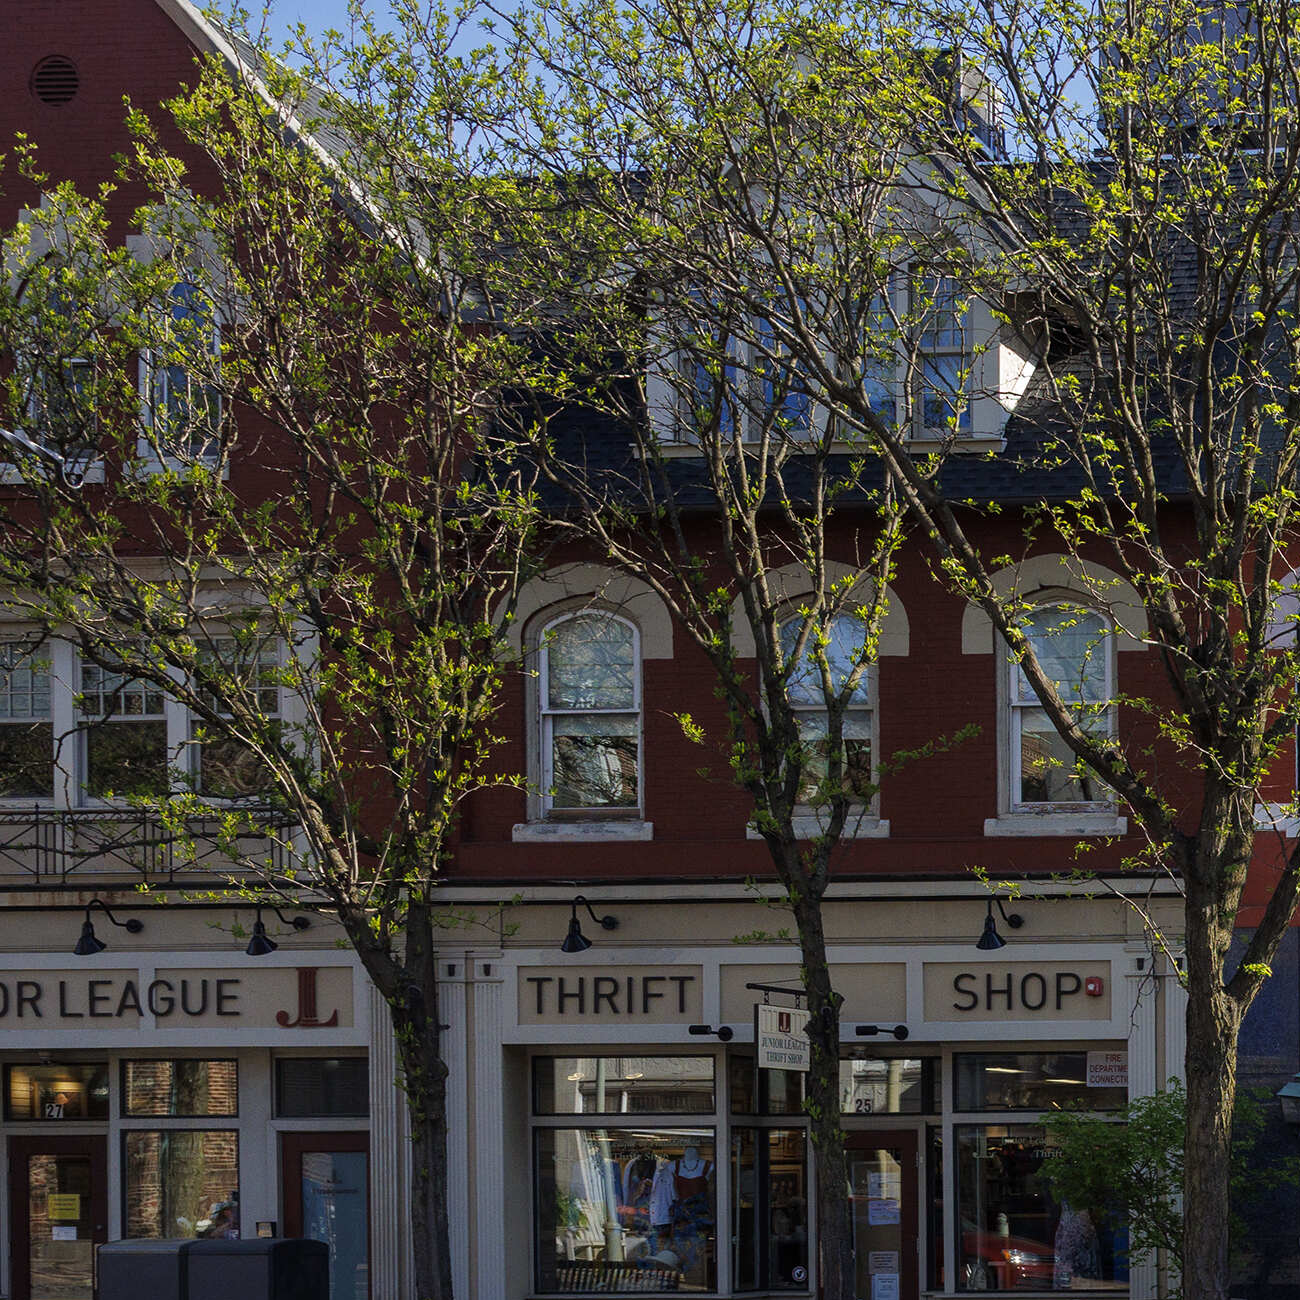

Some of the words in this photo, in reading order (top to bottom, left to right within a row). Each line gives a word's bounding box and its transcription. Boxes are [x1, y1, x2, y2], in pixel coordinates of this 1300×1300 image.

[59, 979, 241, 1017] LEAGUE
[526, 976, 695, 1014] THRIFT
[952, 972, 1082, 1011] SHOP
[1105, 1054, 1121, 1062] FIRE
[46, 1103, 62, 1118] 27
[855, 1098, 872, 1113] 25
